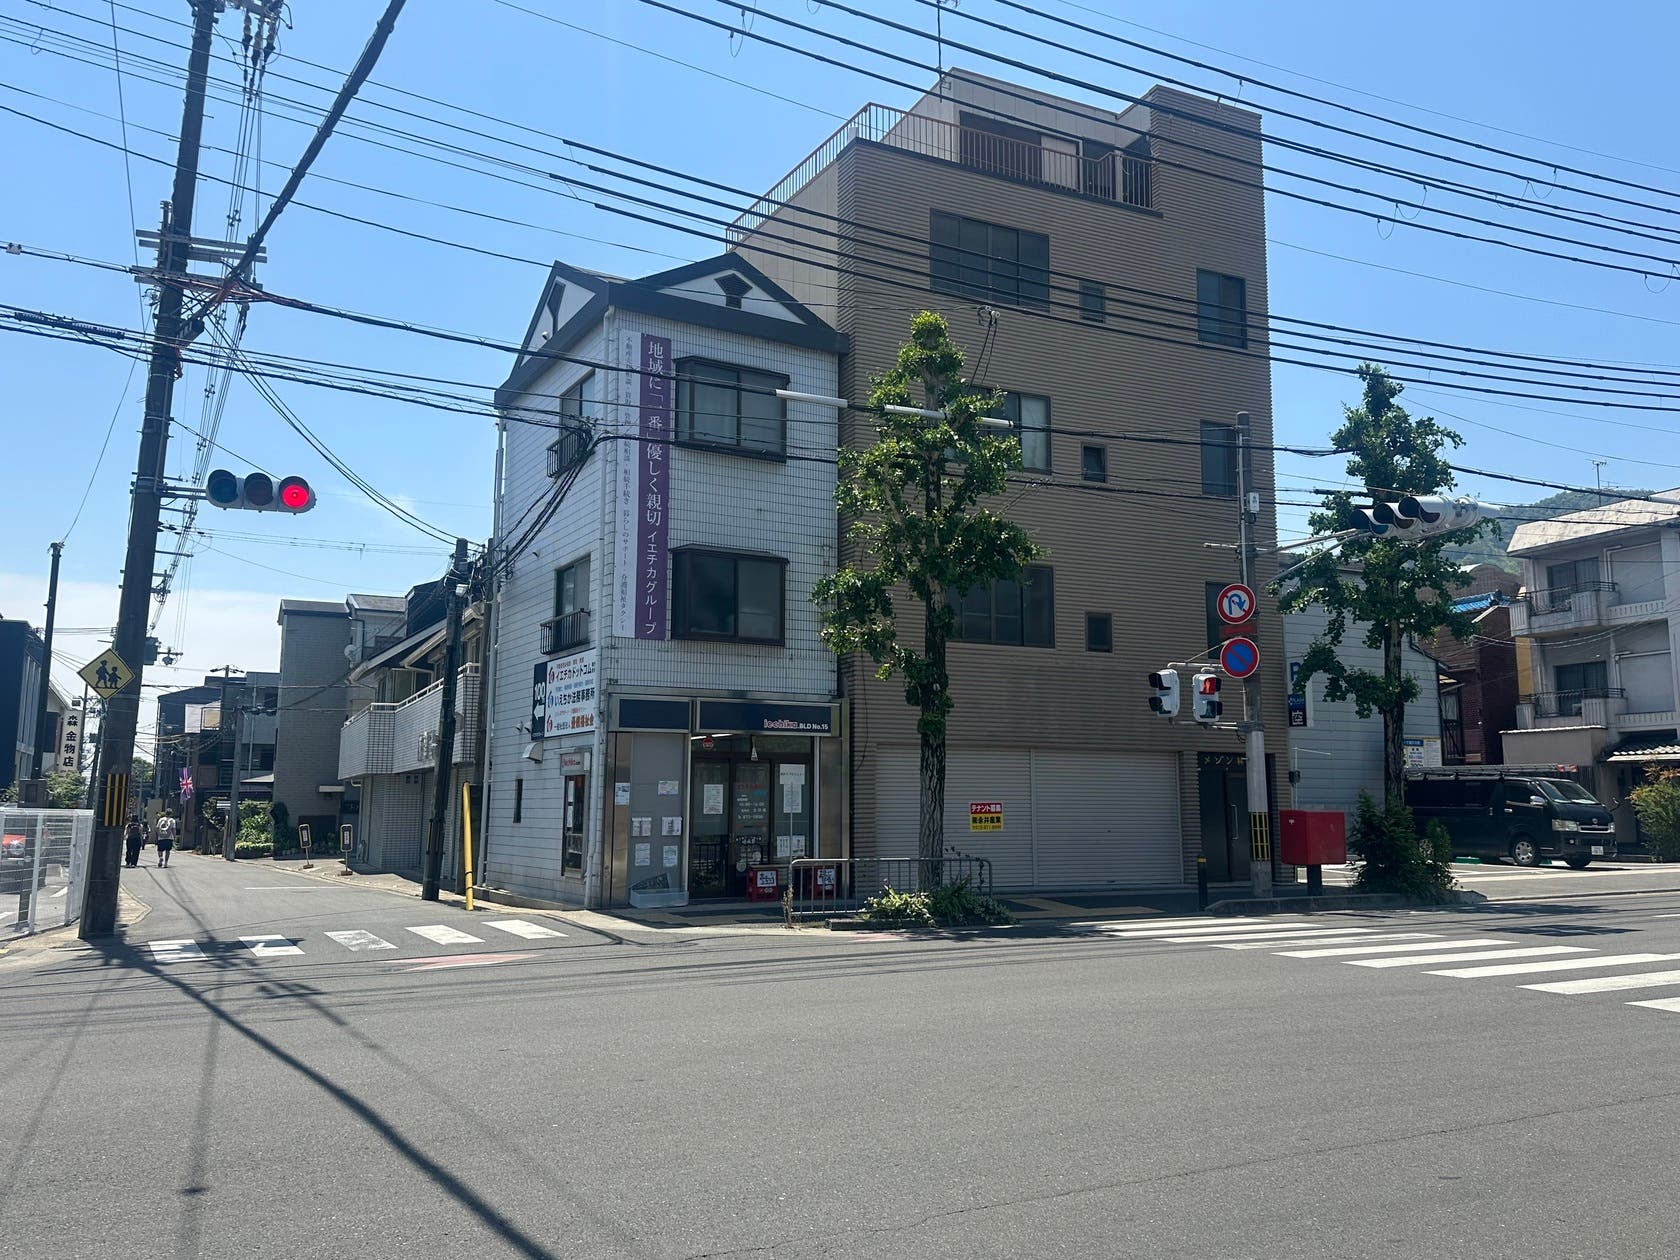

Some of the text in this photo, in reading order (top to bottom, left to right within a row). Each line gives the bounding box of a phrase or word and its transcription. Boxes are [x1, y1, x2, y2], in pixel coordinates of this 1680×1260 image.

[645, 531, 659, 634] イエチカグループ
[62, 714, 79, 767] 森金物店
[971, 804, 1002, 813] テナント募集
